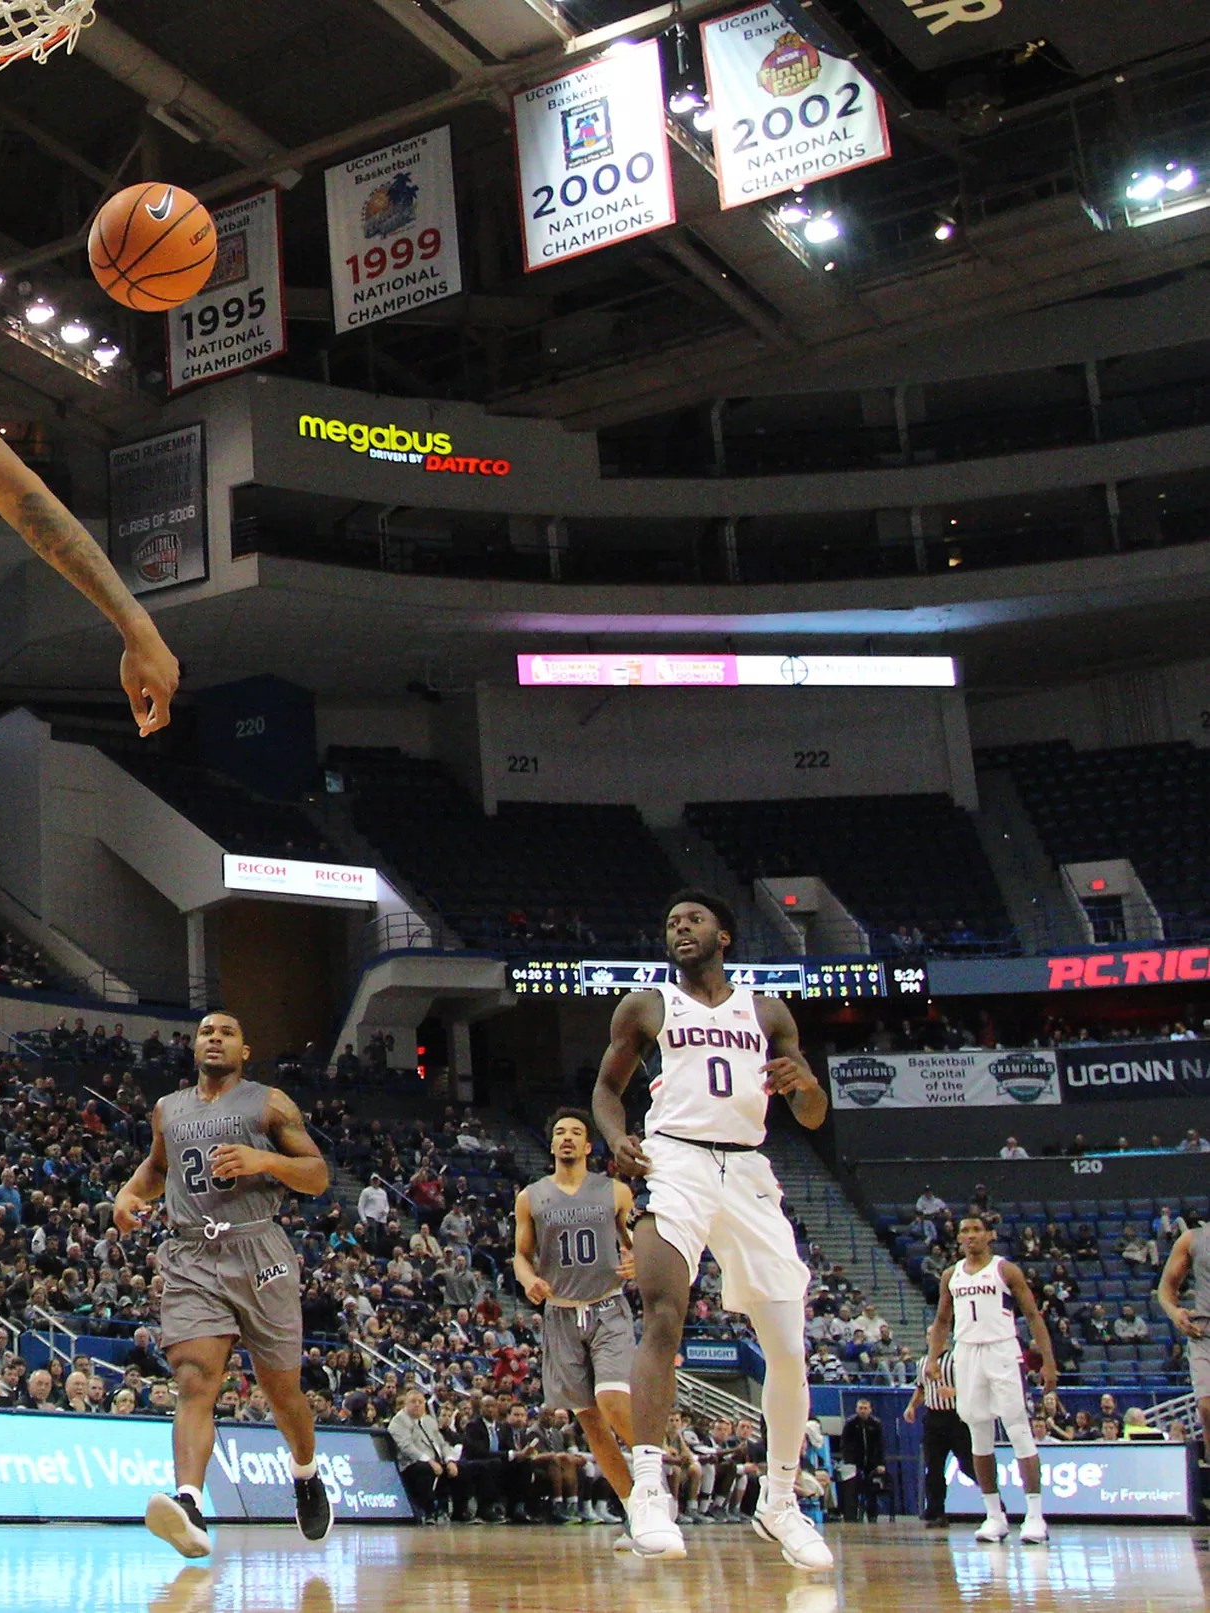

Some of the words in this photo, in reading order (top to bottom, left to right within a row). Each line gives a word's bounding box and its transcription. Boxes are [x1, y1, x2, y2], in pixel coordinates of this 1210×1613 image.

[718, 8, 769, 33] UConn
[743, 18, 793, 41] Baske
[759, 55, 809, 84] Final
[772, 64, 822, 97] Four
[525, 79, 571, 103] UConn
[733, 82, 863, 154] 2002
[345, 151, 388, 174] UConn
[391, 136, 428, 157] Men's
[747, 127, 854, 170] NATIONAL
[354, 152, 421, 185] Basketball
[741, 143, 866, 194] CHAMPIONS
[532, 151, 655, 220] 2000
[213, 195, 267, 222] Women's
[548, 194, 645, 236] NATIONAL
[542, 209, 654, 258] CHAMPIONS
[345, 227, 442, 285] 1999
[353, 265, 440, 304] NATIONAL
[180, 286, 267, 341] 1995
[347, 280, 449, 325] CHAMPIONS
[185, 325, 265, 360] NATIONAL
[181, 339, 273, 380] CHAMPIONS
[298, 415, 453, 455] megabus
[369, 448, 408, 463] DRIVEN
[409, 453, 424, 464] BY
[425, 454, 512, 476] DATTCO
[118, 518, 151, 537] CLASS
[152, 512, 166, 529] OF
[168, 504, 196, 524] 2006
[235, 716, 265, 738] 220
[507, 755, 540, 773] 221
[794, 750, 831, 769] 222
[237, 862, 287, 876] RICOH
[315, 869, 363, 884] RICOH
[544, 970, 552, 980] 2
[558, 970, 565, 980] 1
[572, 970, 579, 981] 1
[633, 967, 657, 983] 47
[729, 969, 757, 985] 44
[823, 972, 833, 984] 0
[839, 972, 845, 983] 1
[854, 971, 861, 983] 1
[867, 971, 878, 983] 0
[893, 968, 925, 982] 5:24
[1121, 947, 1210, 984] RIC
[515, 983, 527, 994] 21
[531, 983, 540, 994] 2
[544, 983, 553, 994] 0
[573, 983, 581, 994] 2
[613, 987, 620, 996] 0
[806, 986, 822, 998] 23
[825, 987, 833, 997] 1
[855, 985, 862, 997] 1
[871, 985, 878, 996] 1
[900, 982, 921, 994] PM
[666, 1026, 761, 1053] UCONN
[831, 1065, 897, 1078] CHAMPIONS
[908, 1056, 976, 1067] Basketball
[990, 1062, 1055, 1074] CHAMPIONS
[1067, 1059, 1175, 1087] UCONN
[707, 1056, 734, 1099] 0
[920, 1068, 966, 1081] Capital
[925, 1081, 938, 1091] of
[942, 1081, 963, 1091] the
[926, 1092, 966, 1103] World
[171, 1116, 242, 1144] MONMOUTH
[1070, 1160, 1103, 1174] 120
[542, 1206, 606, 1226] MONMOUTH
[558, 1228, 598, 1268] 10
[254, 1263, 288, 1291] MAAC
[951, 1285, 997, 1299] UCONN
[969, 1300, 978, 1322] 1
[688, 1349, 708, 1357] BUD
[709, 1349, 734, 1358] LIGHT
[90, 1447, 176, 1487] Voice
[343, 1490, 358, 1512] by
[1100, 1488, 1119, 1504] by
